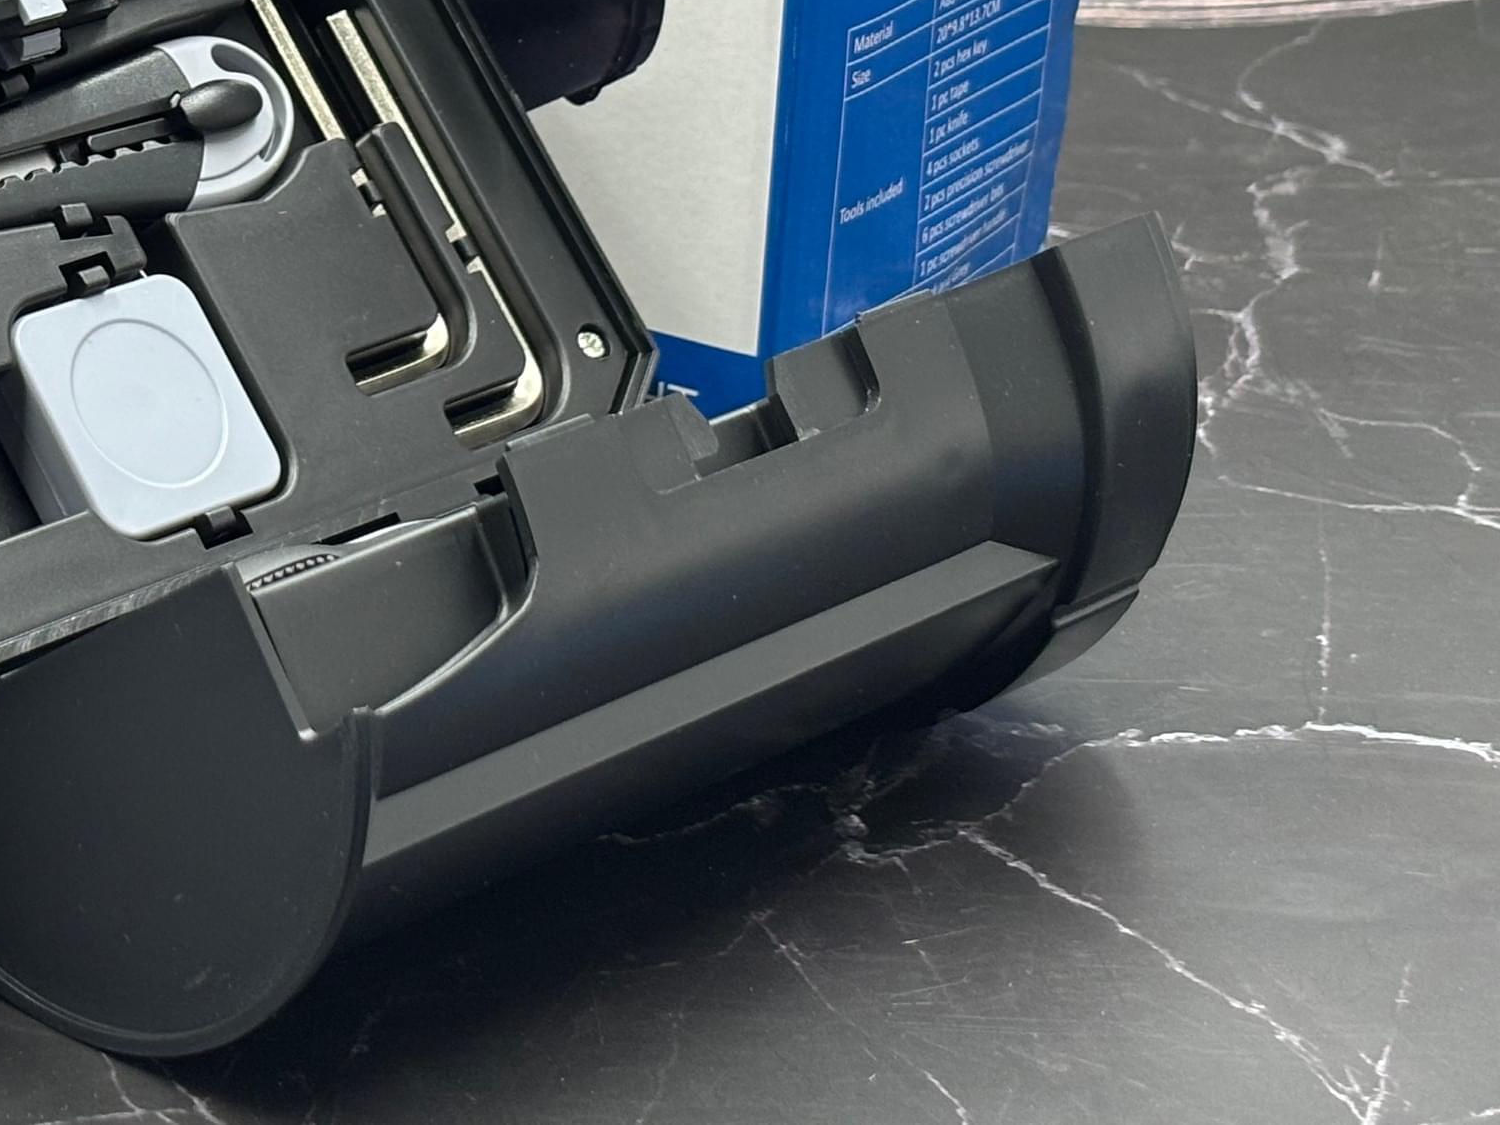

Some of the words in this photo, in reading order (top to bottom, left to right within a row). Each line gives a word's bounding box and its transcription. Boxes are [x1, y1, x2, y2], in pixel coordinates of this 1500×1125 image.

[853, 20, 895, 55] Material
[933, 61, 940, 78] 2
[940, 53, 956, 76] pcs
[956, 47, 972, 66] hex
[972, 38, 988, 56] key
[851, 68, 872, 89] Size
[931, 94, 937, 111] 1
[937, 90, 949, 111] pc
[950, 80, 970, 101] tape
[929, 127, 935, 145] 1
[935, 123, 947, 145] pc
[947, 109, 969, 134] knife
[926, 161, 933, 176] 4
[933, 155, 949, 177] pcs
[949, 137, 980, 166] sockets
[839, 200, 865, 225] Tools
[865, 176, 904, 212] included
[924, 194, 931, 211] 2
[931, 188, 946, 211] pcs
[946, 167, 984, 202] precision
[922, 226, 928, 244] 6
[928, 220, 945, 244] pcs
[945, 195, 989, 231] screwdriver
[920, 260, 926, 277] 1
[927, 255, 939, 276] pc
